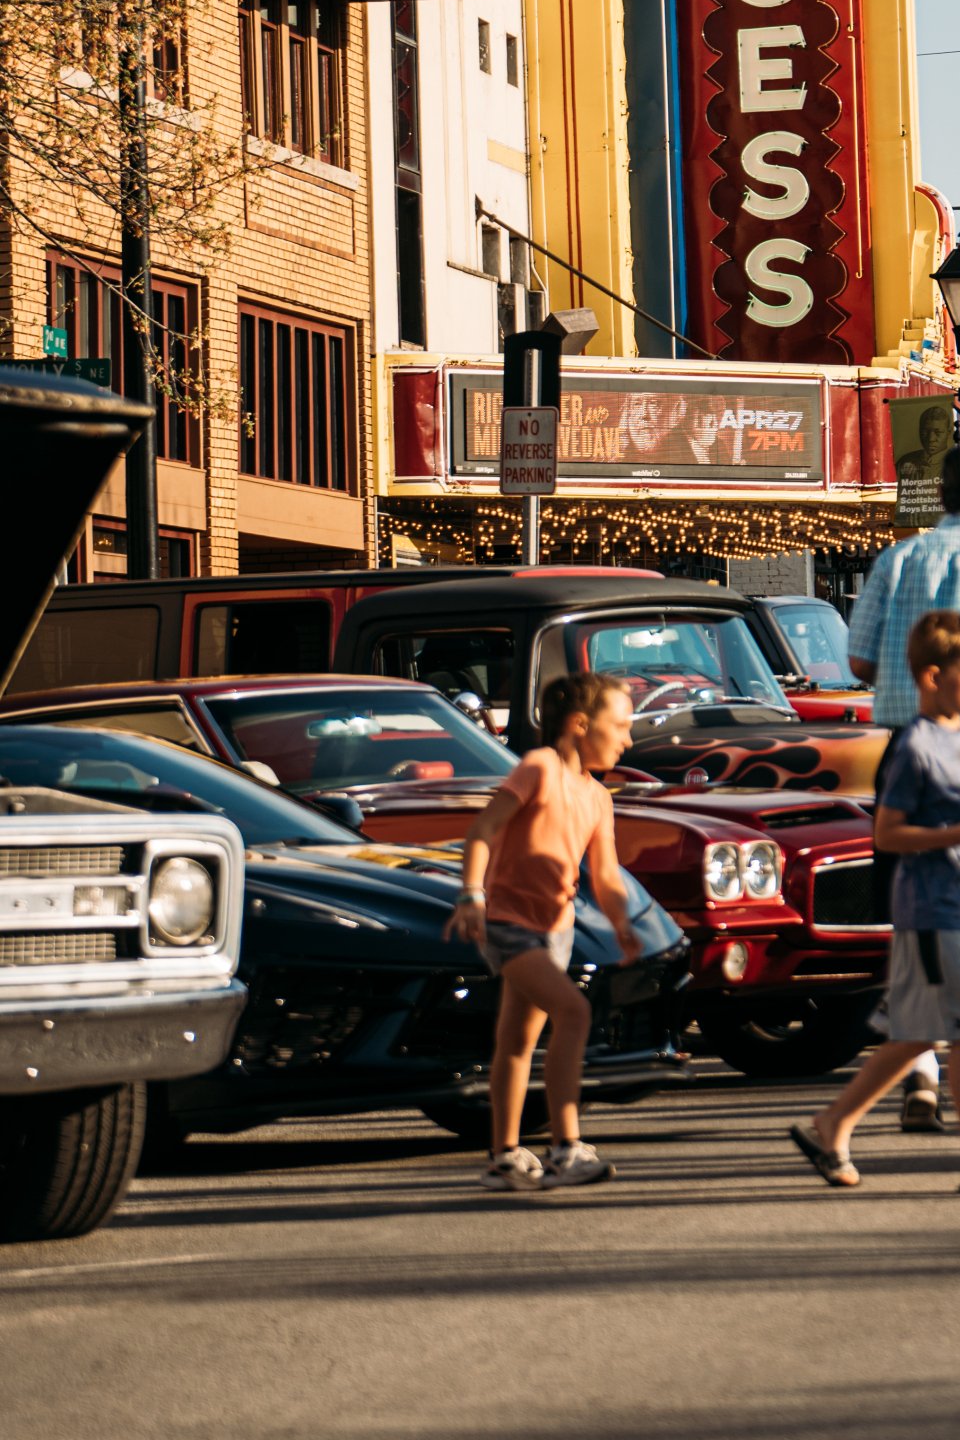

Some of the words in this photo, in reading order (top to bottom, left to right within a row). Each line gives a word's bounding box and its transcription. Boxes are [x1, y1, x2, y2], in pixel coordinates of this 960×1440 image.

[90, 367, 105, 378] NE
[519, 420, 540, 436] NO
[748, 431, 804, 452] 7PM
[505, 444, 553, 459] REVERSE
[505, 467, 553, 483] PARKING
[901, 487, 937, 495] Archives
[900, 505, 920, 513] Boys
